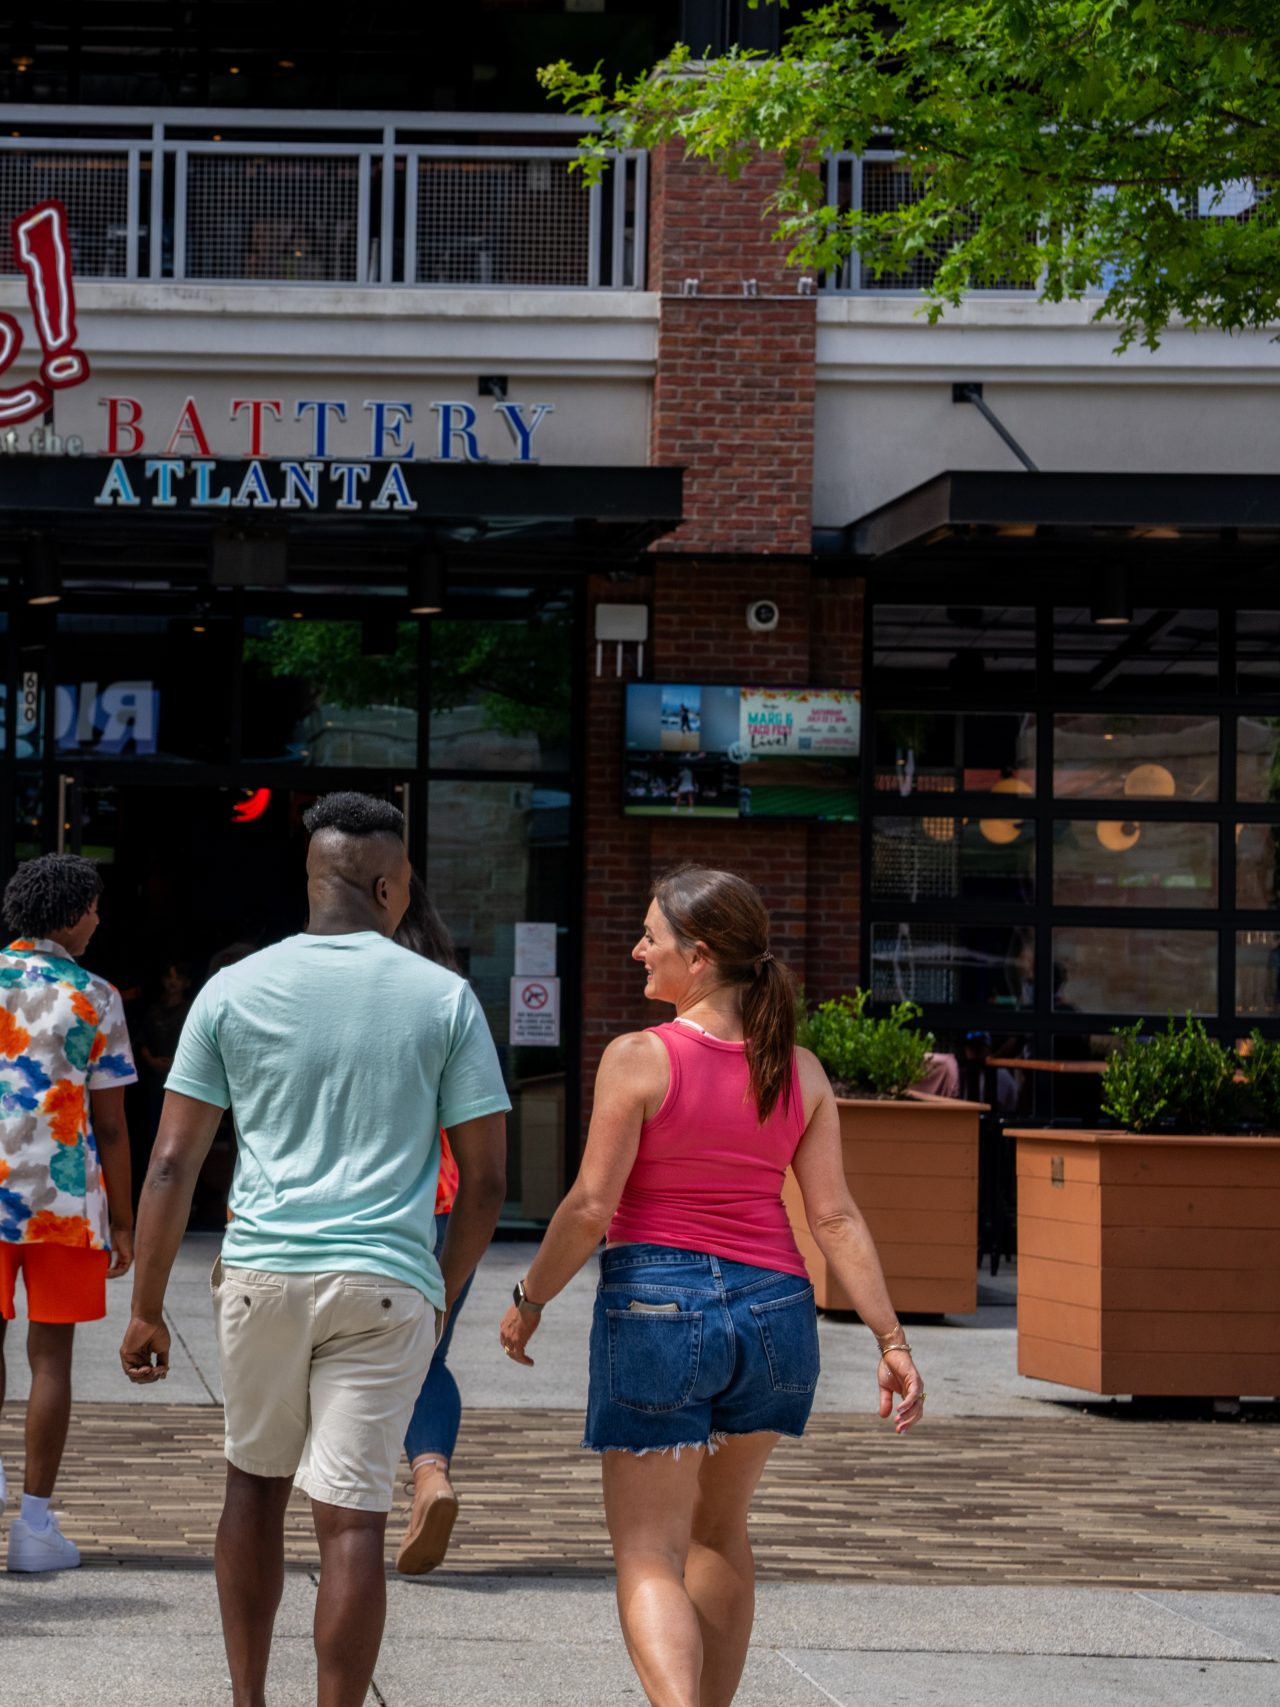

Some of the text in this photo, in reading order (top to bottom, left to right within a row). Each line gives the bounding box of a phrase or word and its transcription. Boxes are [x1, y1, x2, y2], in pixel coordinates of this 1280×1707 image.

[30, 423, 84, 457] the
[98, 396, 554, 464] BATTERY
[94, 458, 418, 510] ATLANTA
[24, 673, 36, 721] 600
